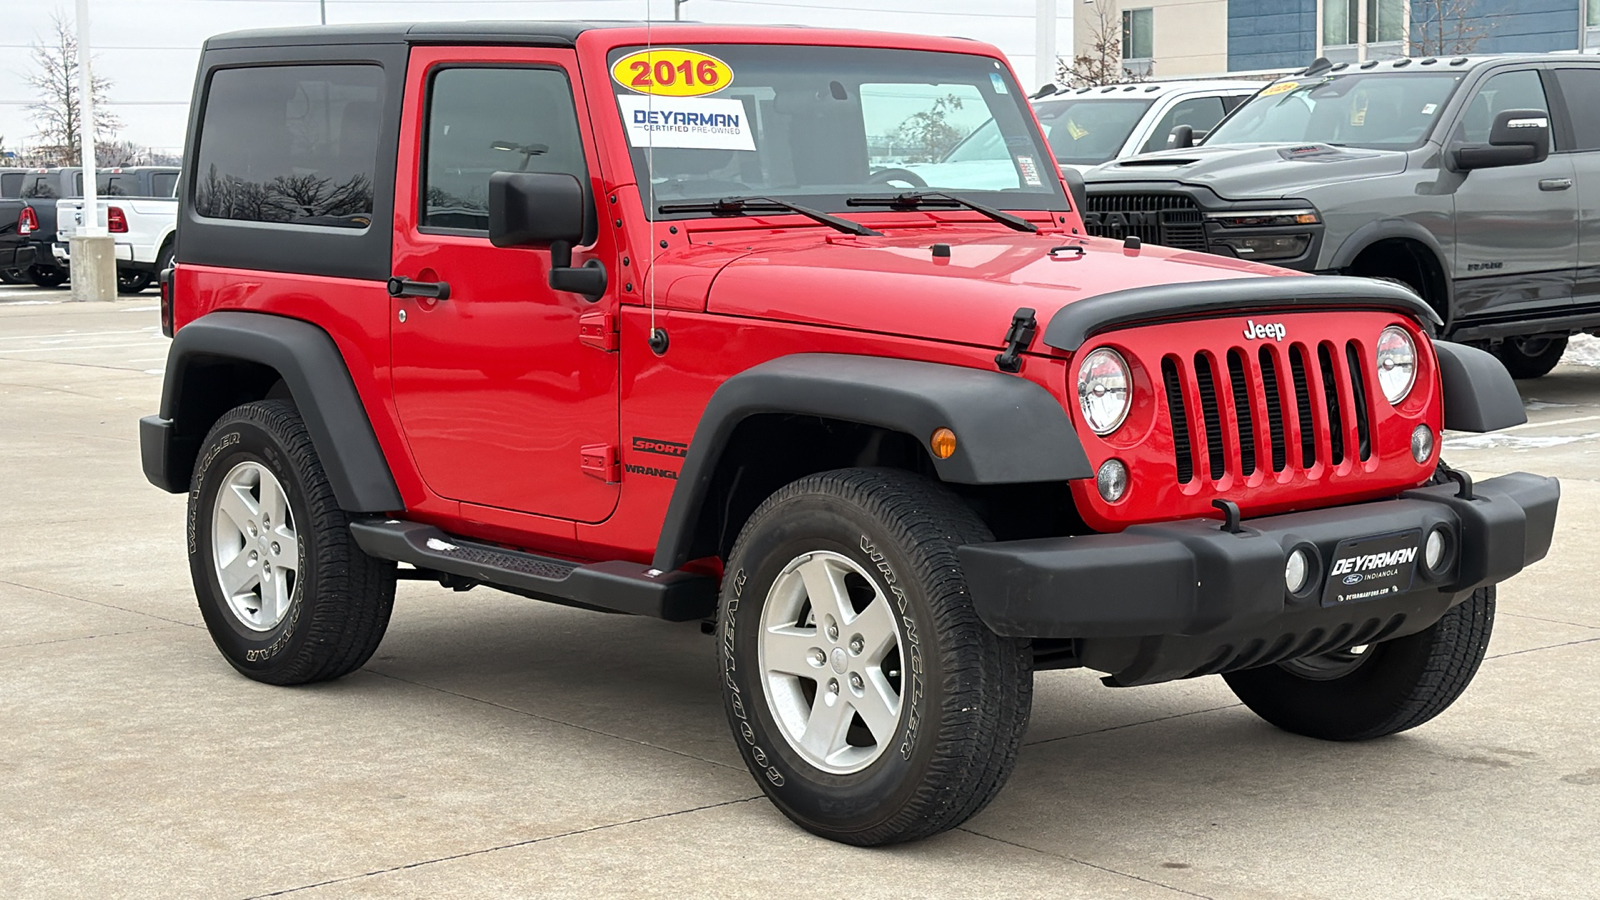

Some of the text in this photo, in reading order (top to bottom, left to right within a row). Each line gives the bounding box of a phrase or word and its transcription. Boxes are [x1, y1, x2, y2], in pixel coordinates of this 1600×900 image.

[630, 60, 719, 87] 2016
[633, 110, 739, 127] DEYARMAN
[1084, 211, 1158, 226] RAM
[1243, 319, 1286, 342] Jeep
[635, 440, 686, 454] SPORT
[625, 464, 678, 480] WRANGL
[188, 432, 240, 555] WRANGLER
[1331, 547, 1418, 576] DEYARMAN
[1364, 569, 1398, 580] INDIANOLA
[859, 535, 923, 760] WRANGLER
[723, 567, 785, 787] GOODYEAR
